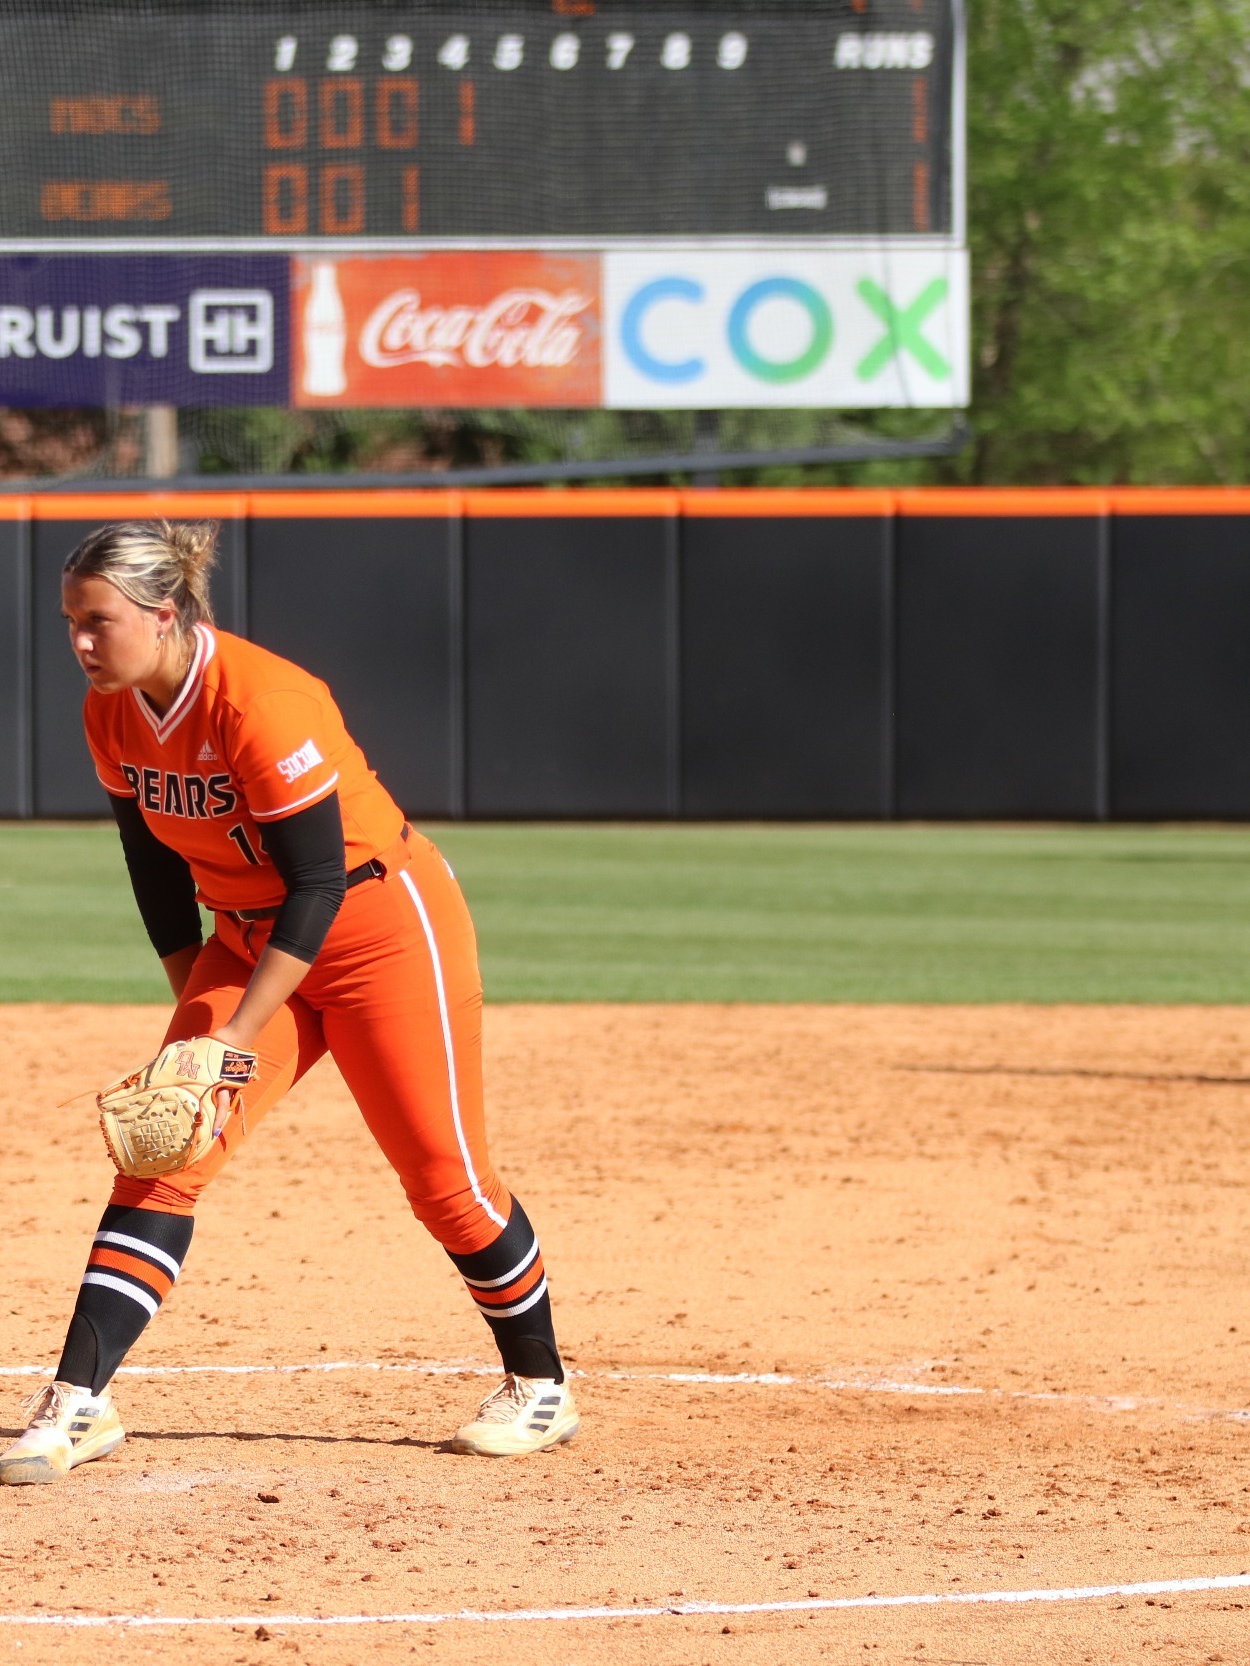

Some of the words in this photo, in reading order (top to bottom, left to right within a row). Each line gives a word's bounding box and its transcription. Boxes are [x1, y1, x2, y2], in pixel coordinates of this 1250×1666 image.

[274, 35, 298, 71] 1
[327, 35, 359, 71] 2
[382, 35, 413, 71] 3
[438, 34, 470, 70] 4
[494, 34, 524, 71] 5
[550, 33, 580, 70] 6
[607, 33, 635, 70] 7
[661, 33, 691, 70] 8
[718, 32, 748, 70] 9
[833, 31, 934, 70] RUNS
[617, 276, 951, 384] COX
[120, 762, 237, 820] BEARS
